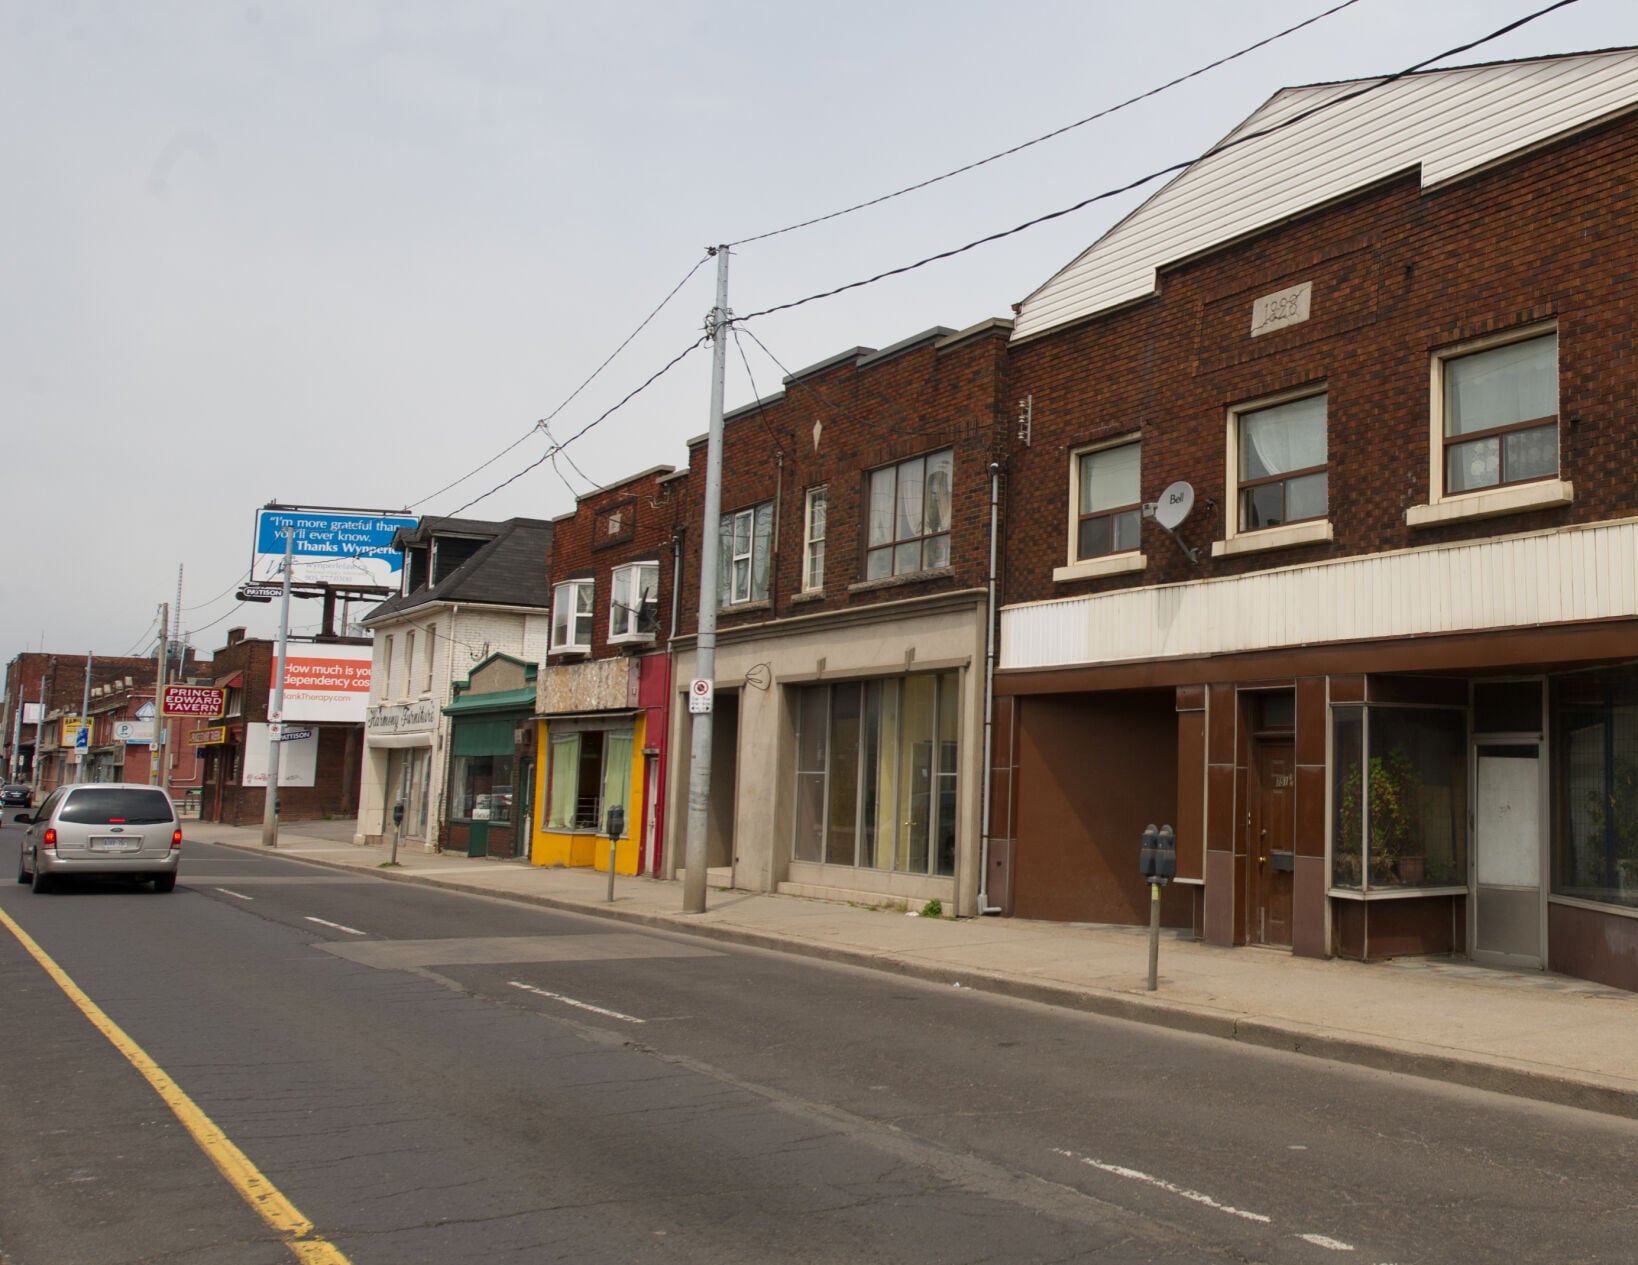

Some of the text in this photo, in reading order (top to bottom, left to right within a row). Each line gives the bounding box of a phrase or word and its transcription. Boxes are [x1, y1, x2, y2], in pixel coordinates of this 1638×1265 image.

[1169, 492, 1185, 505] Bell
[297, 519, 328, 529] more
[331, 519, 373, 534] grateful
[309, 532, 335, 541] ever
[338, 531, 372, 542] know.
[296, 540, 338, 552] Thanks
[312, 665, 342, 675] much
[345, 666, 354, 675] is
[284, 674, 350, 688] dependency
[169, 688, 220, 698] PRINCE
[165, 696, 222, 705] EDWARD
[167, 703, 219, 712] TAVERN
[400, 701, 435, 726] Furniture
[281, 731, 311, 741] ATTISON
